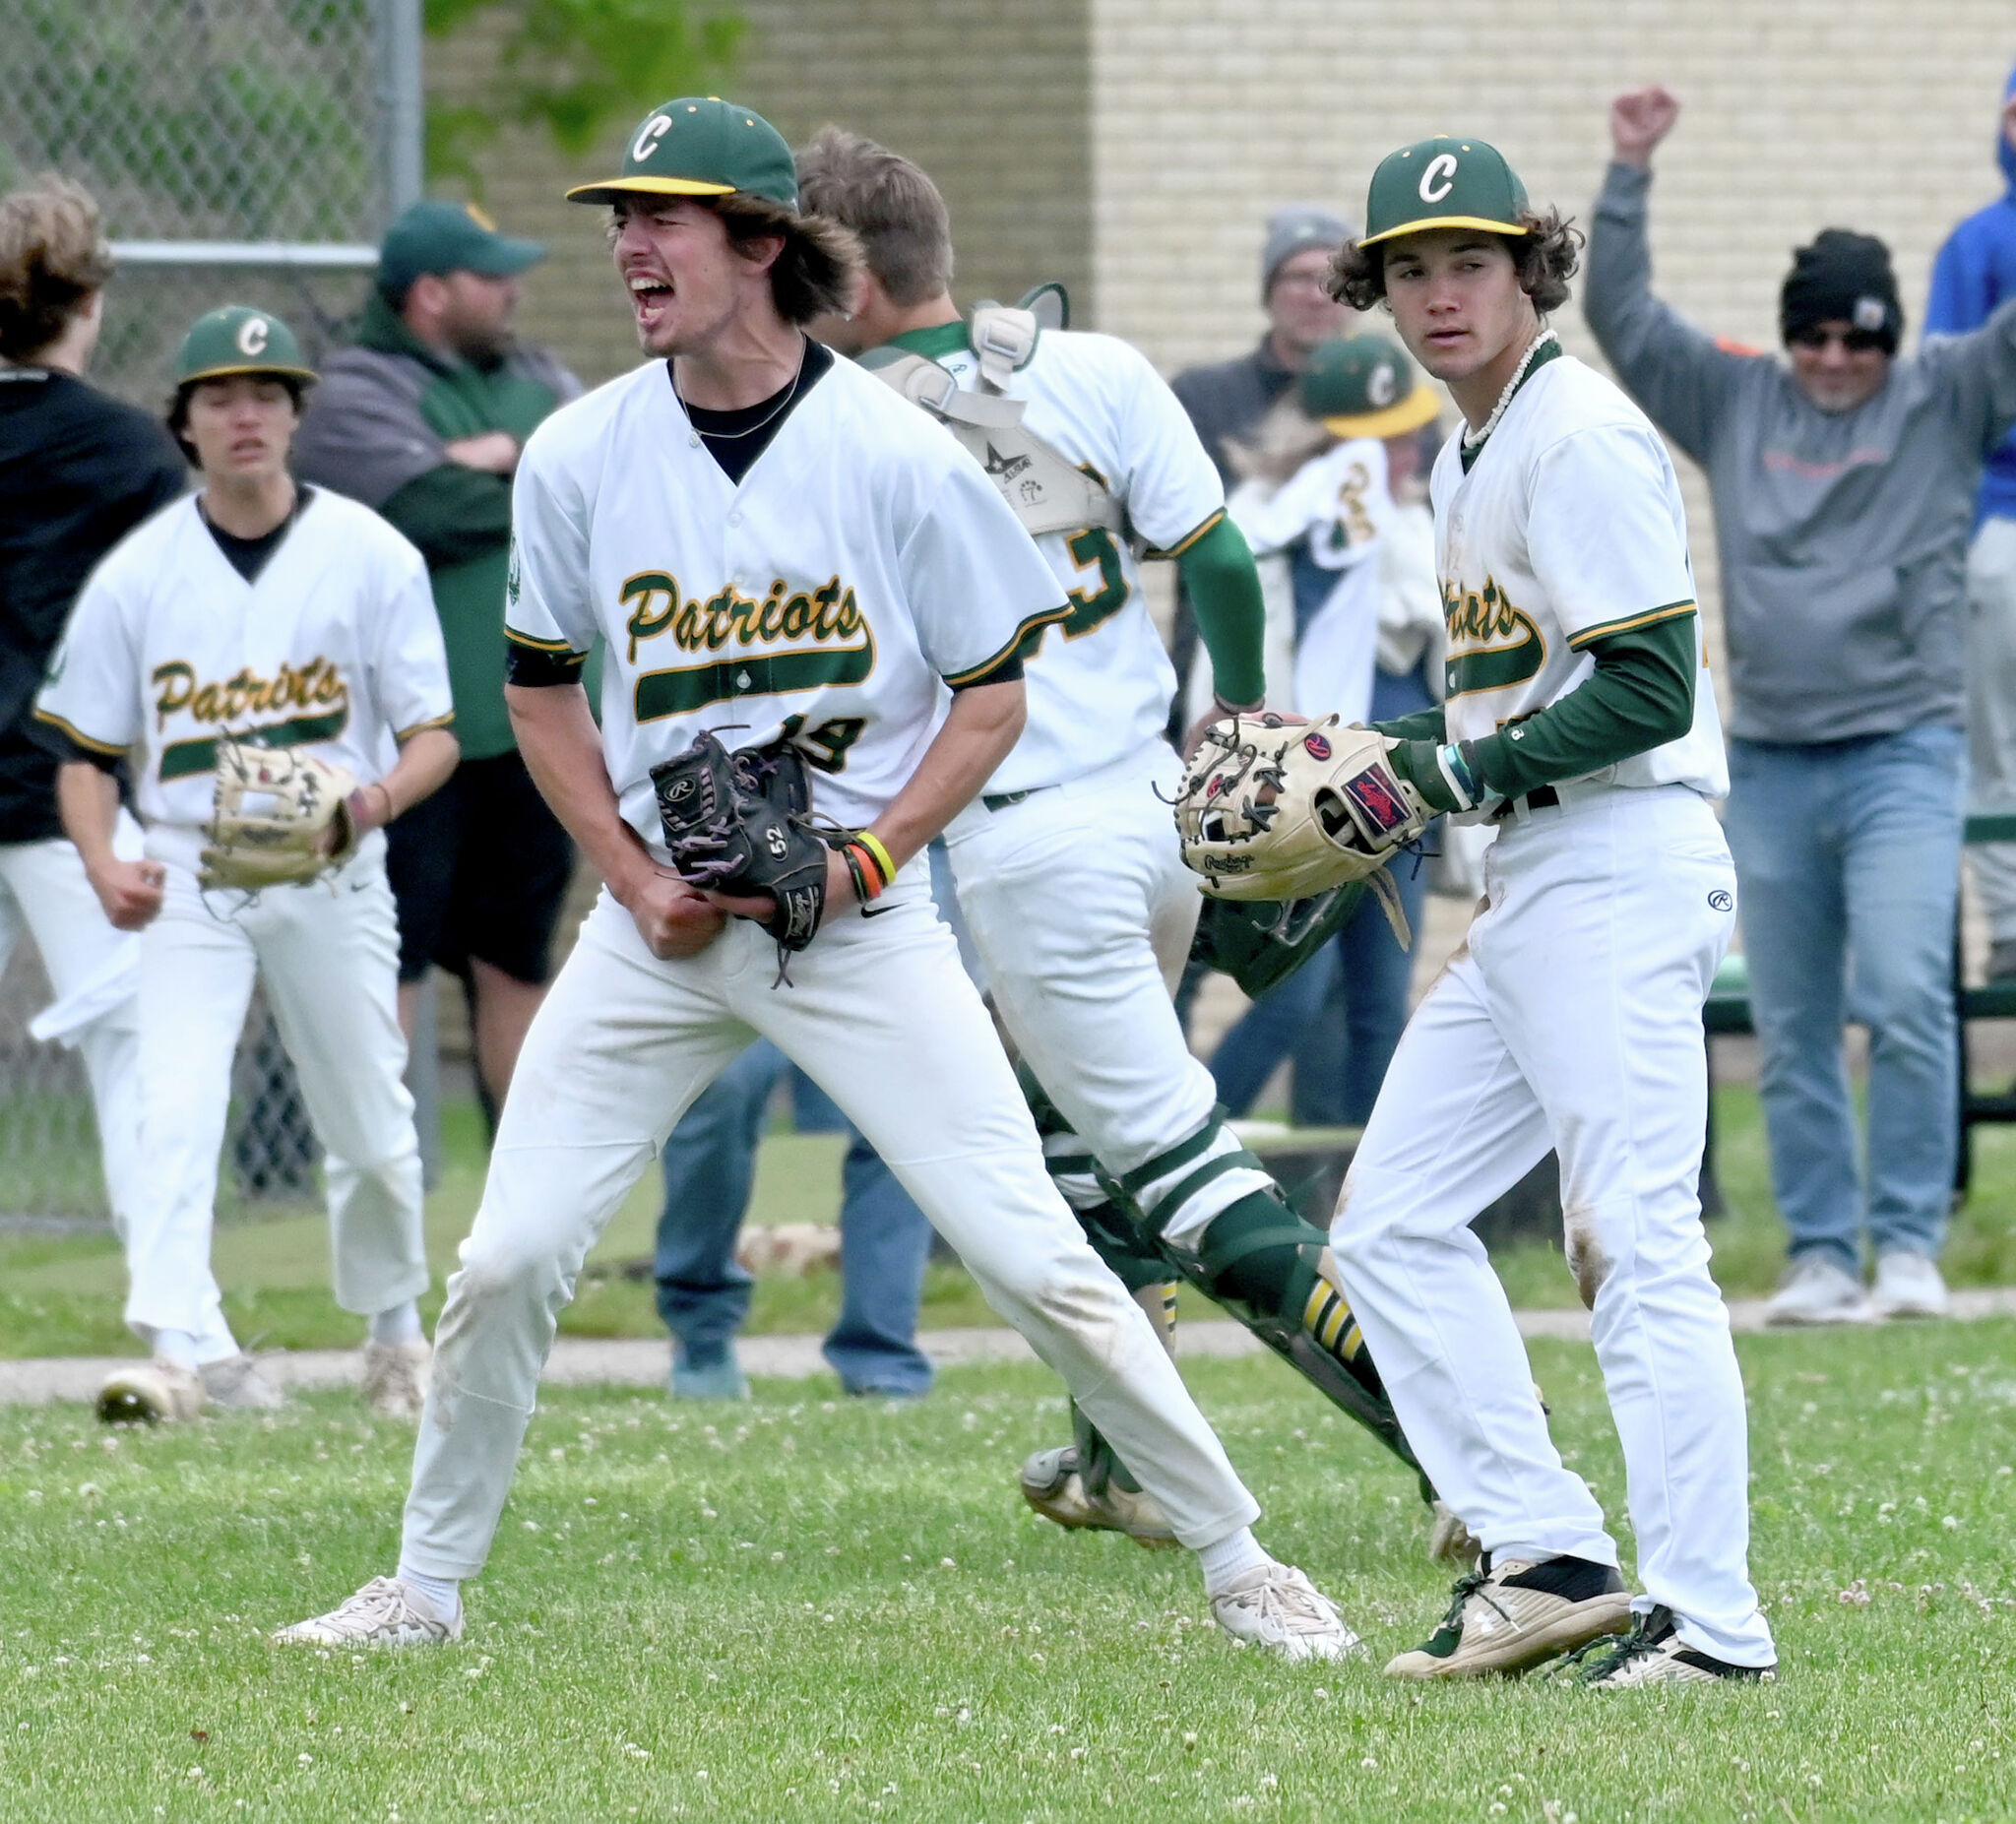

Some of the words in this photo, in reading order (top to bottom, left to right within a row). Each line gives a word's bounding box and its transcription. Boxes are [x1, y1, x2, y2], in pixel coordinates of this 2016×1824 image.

[633, 115, 672, 162] C
[1418, 154, 1458, 203] C
[239, 318, 268, 355] C
[618, 570, 870, 665] Patriots
[152, 655, 347, 734] Patriots
